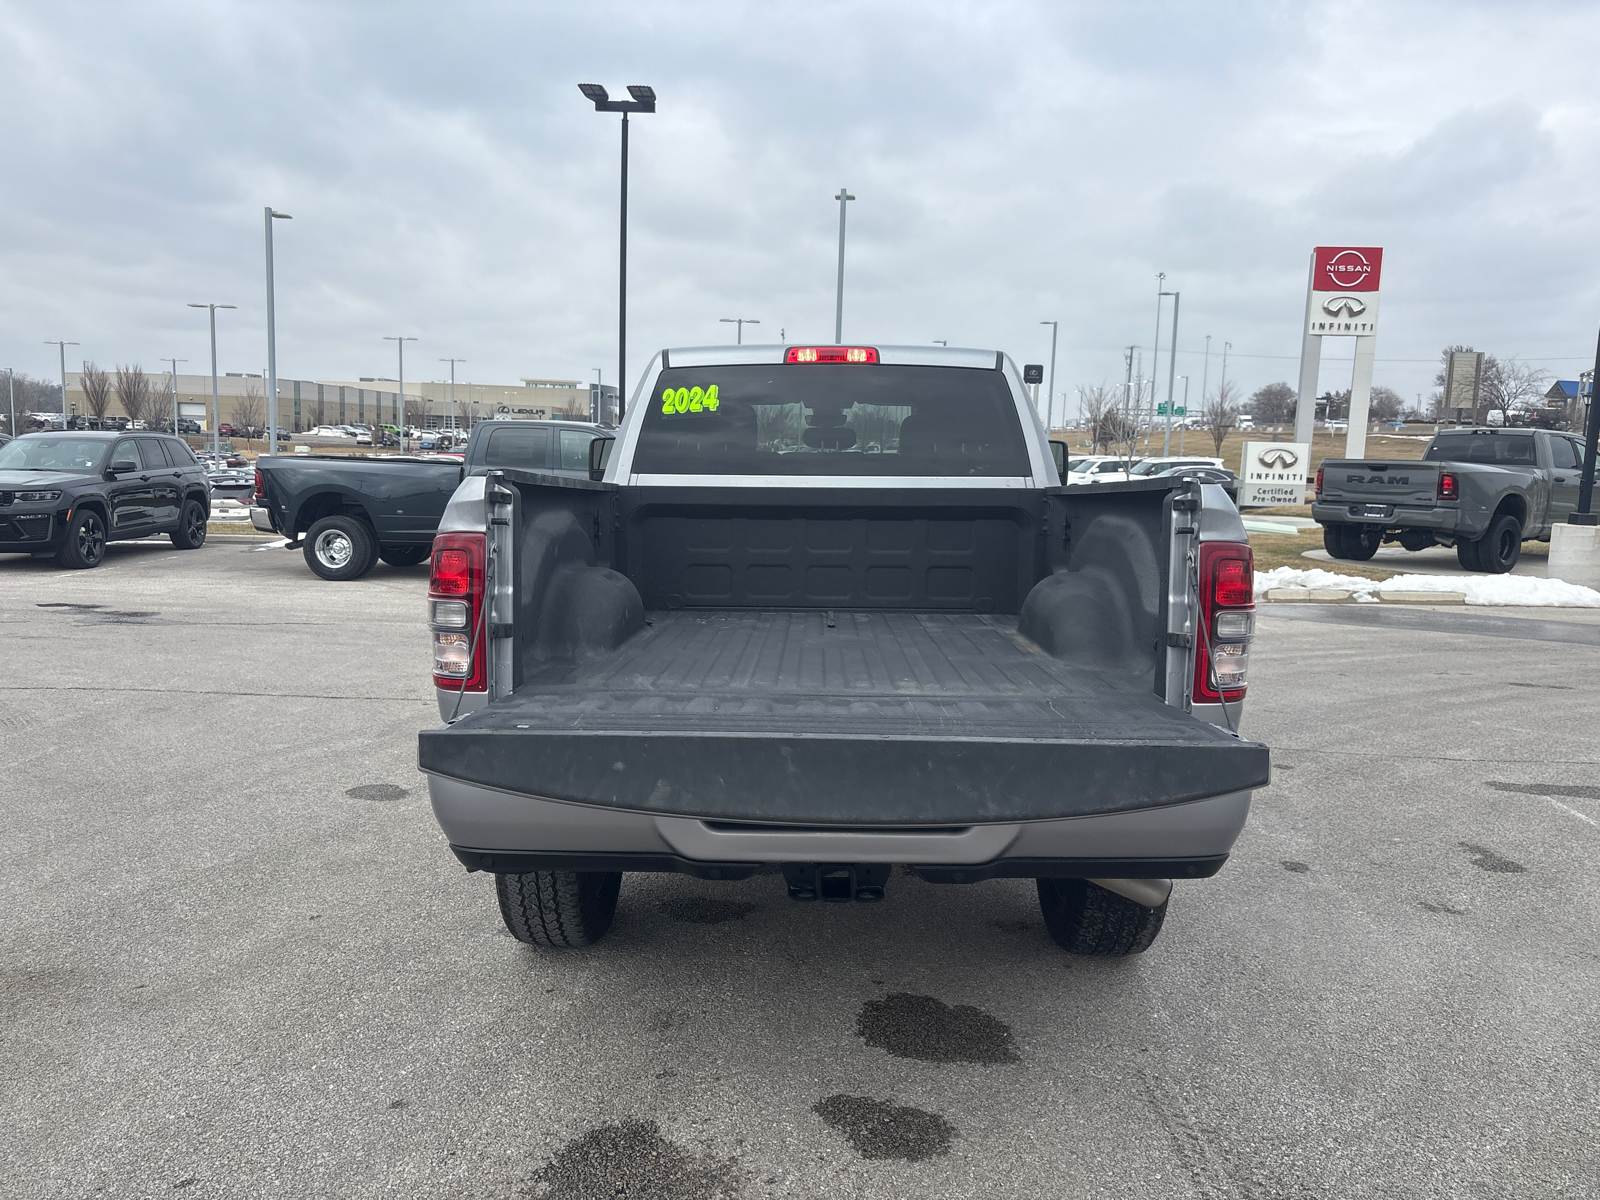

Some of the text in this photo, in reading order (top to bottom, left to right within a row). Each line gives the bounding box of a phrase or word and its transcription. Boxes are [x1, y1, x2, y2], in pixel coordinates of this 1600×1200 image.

[1312, 322, 1373, 331] INFINITI
[662, 384, 719, 415] 2024
[1250, 472, 1303, 481] INFINITI
[1346, 475, 1409, 485] RAM
[1257, 488, 1294, 496] Certified
[1252, 495, 1297, 503] Pre-Owned
